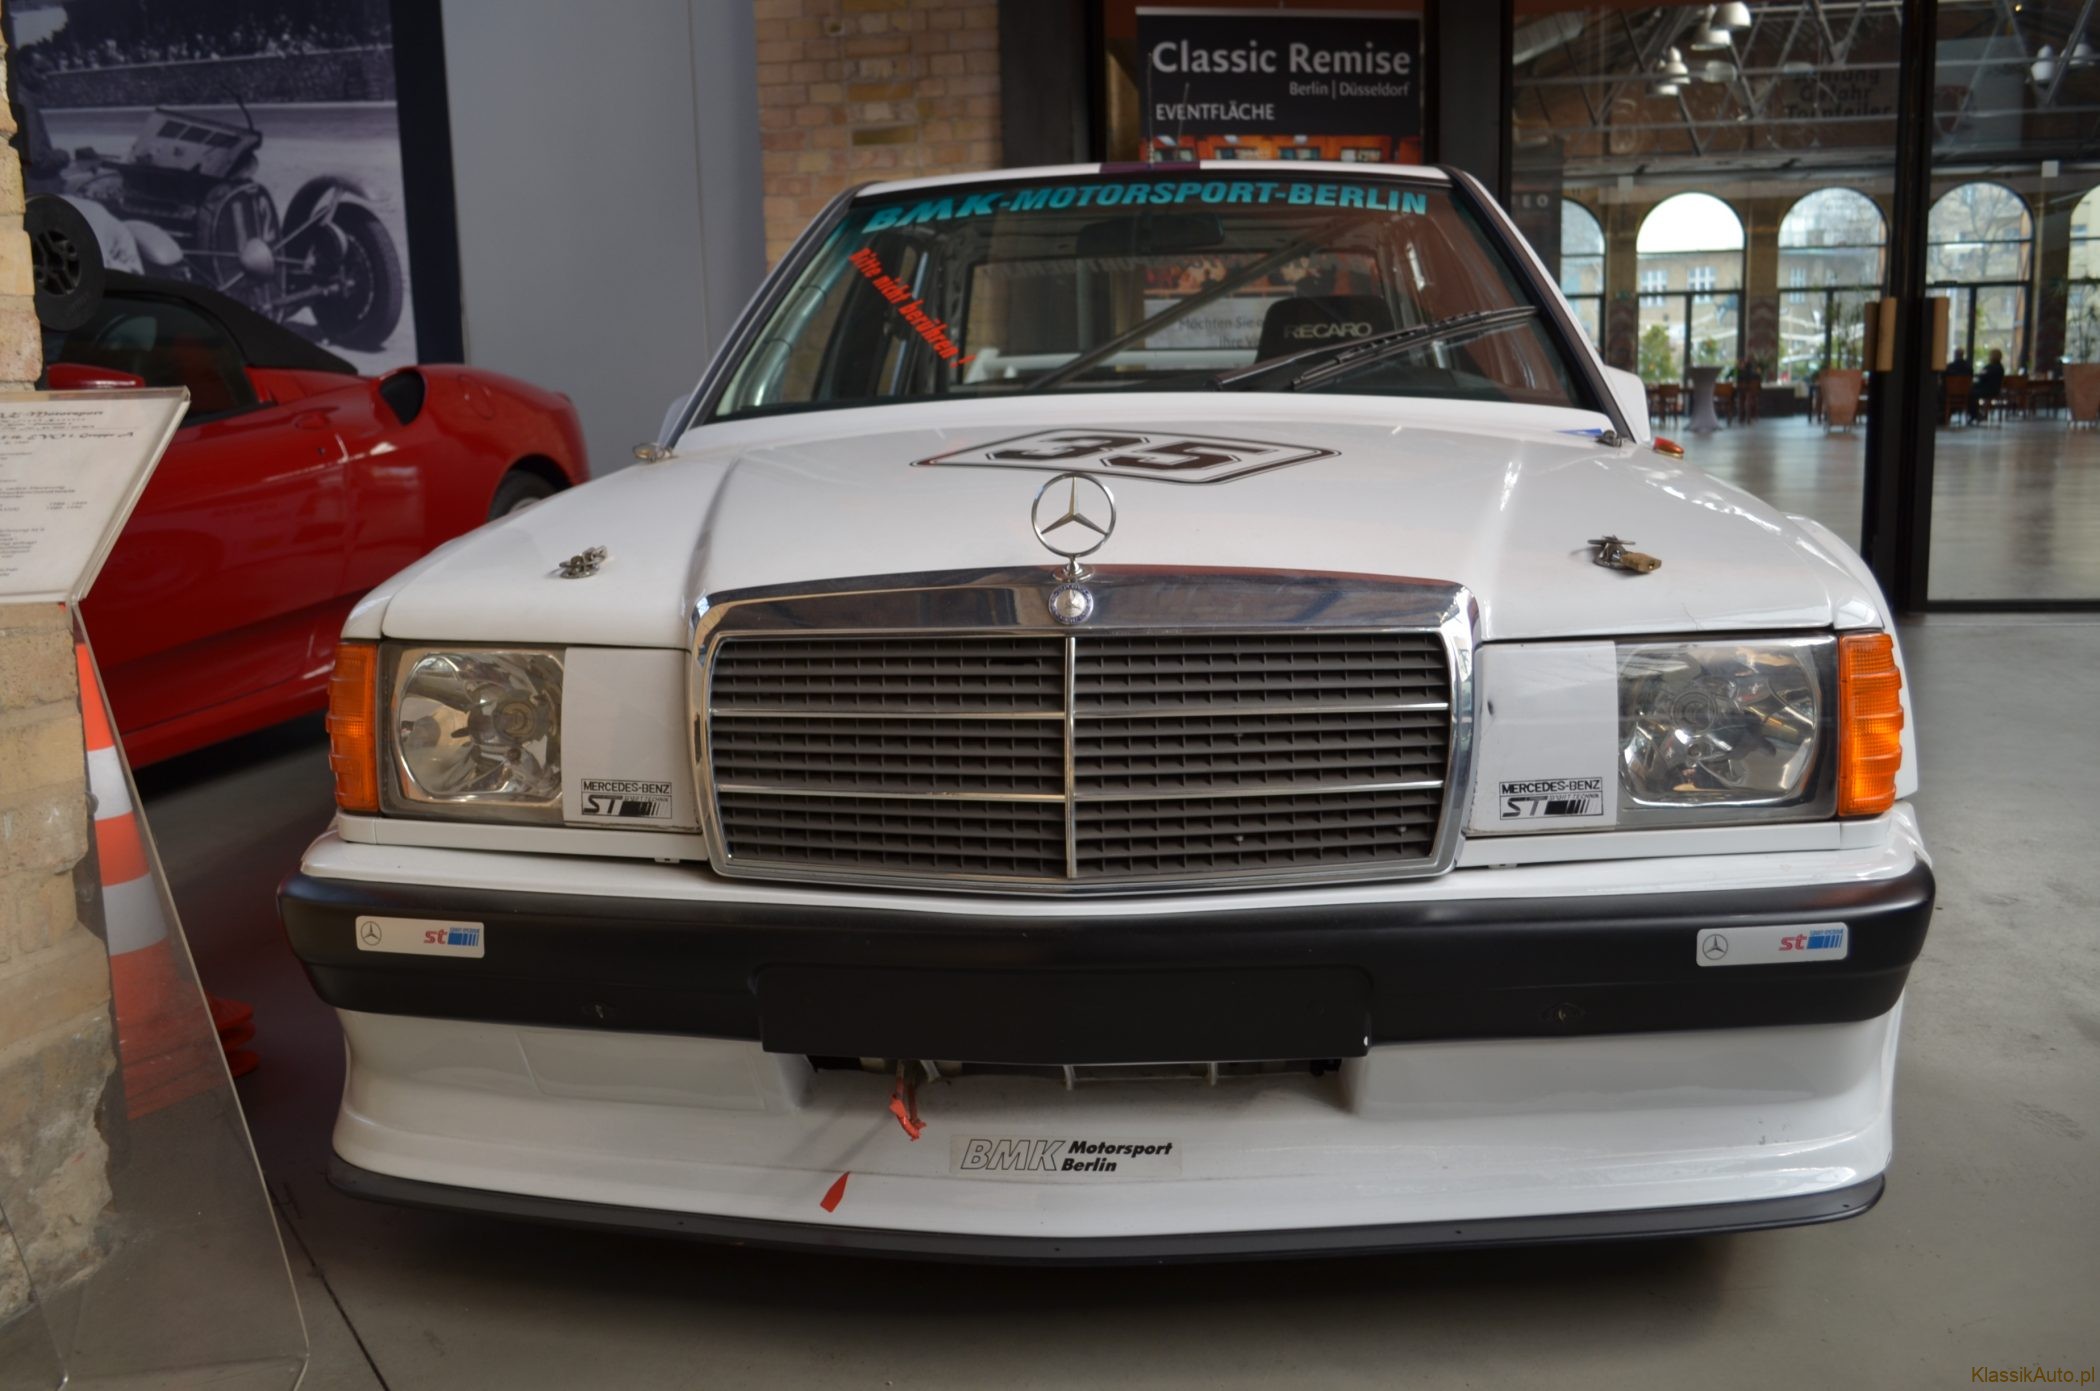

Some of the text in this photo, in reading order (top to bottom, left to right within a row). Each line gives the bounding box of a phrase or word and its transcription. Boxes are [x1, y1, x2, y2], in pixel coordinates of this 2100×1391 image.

[1152, 39, 1411, 75] Classic Remise
[1290, 80, 1411, 97] Berlin Düsseldorf
[1156, 100, 1275, 121] EVENTFLÄCHE
[860, 180, 1428, 235] BMK-MOTORSPORT-BERLIN
[1283, 322, 1373, 339] RECARO
[986, 434, 1278, 471] 35
[583, 781, 670, 794] MERCEDES-BENZ
[1501, 779, 1601, 795] MERCEDES-BENZ
[583, 794, 623, 814] ST
[1502, 796, 1548, 818] ST
[423, 928, 448, 945] st
[1778, 933, 1807, 951] st
[960, 1139, 1173, 1171] BMK Motorsport
[1061, 1157, 1118, 1173] Berlin
